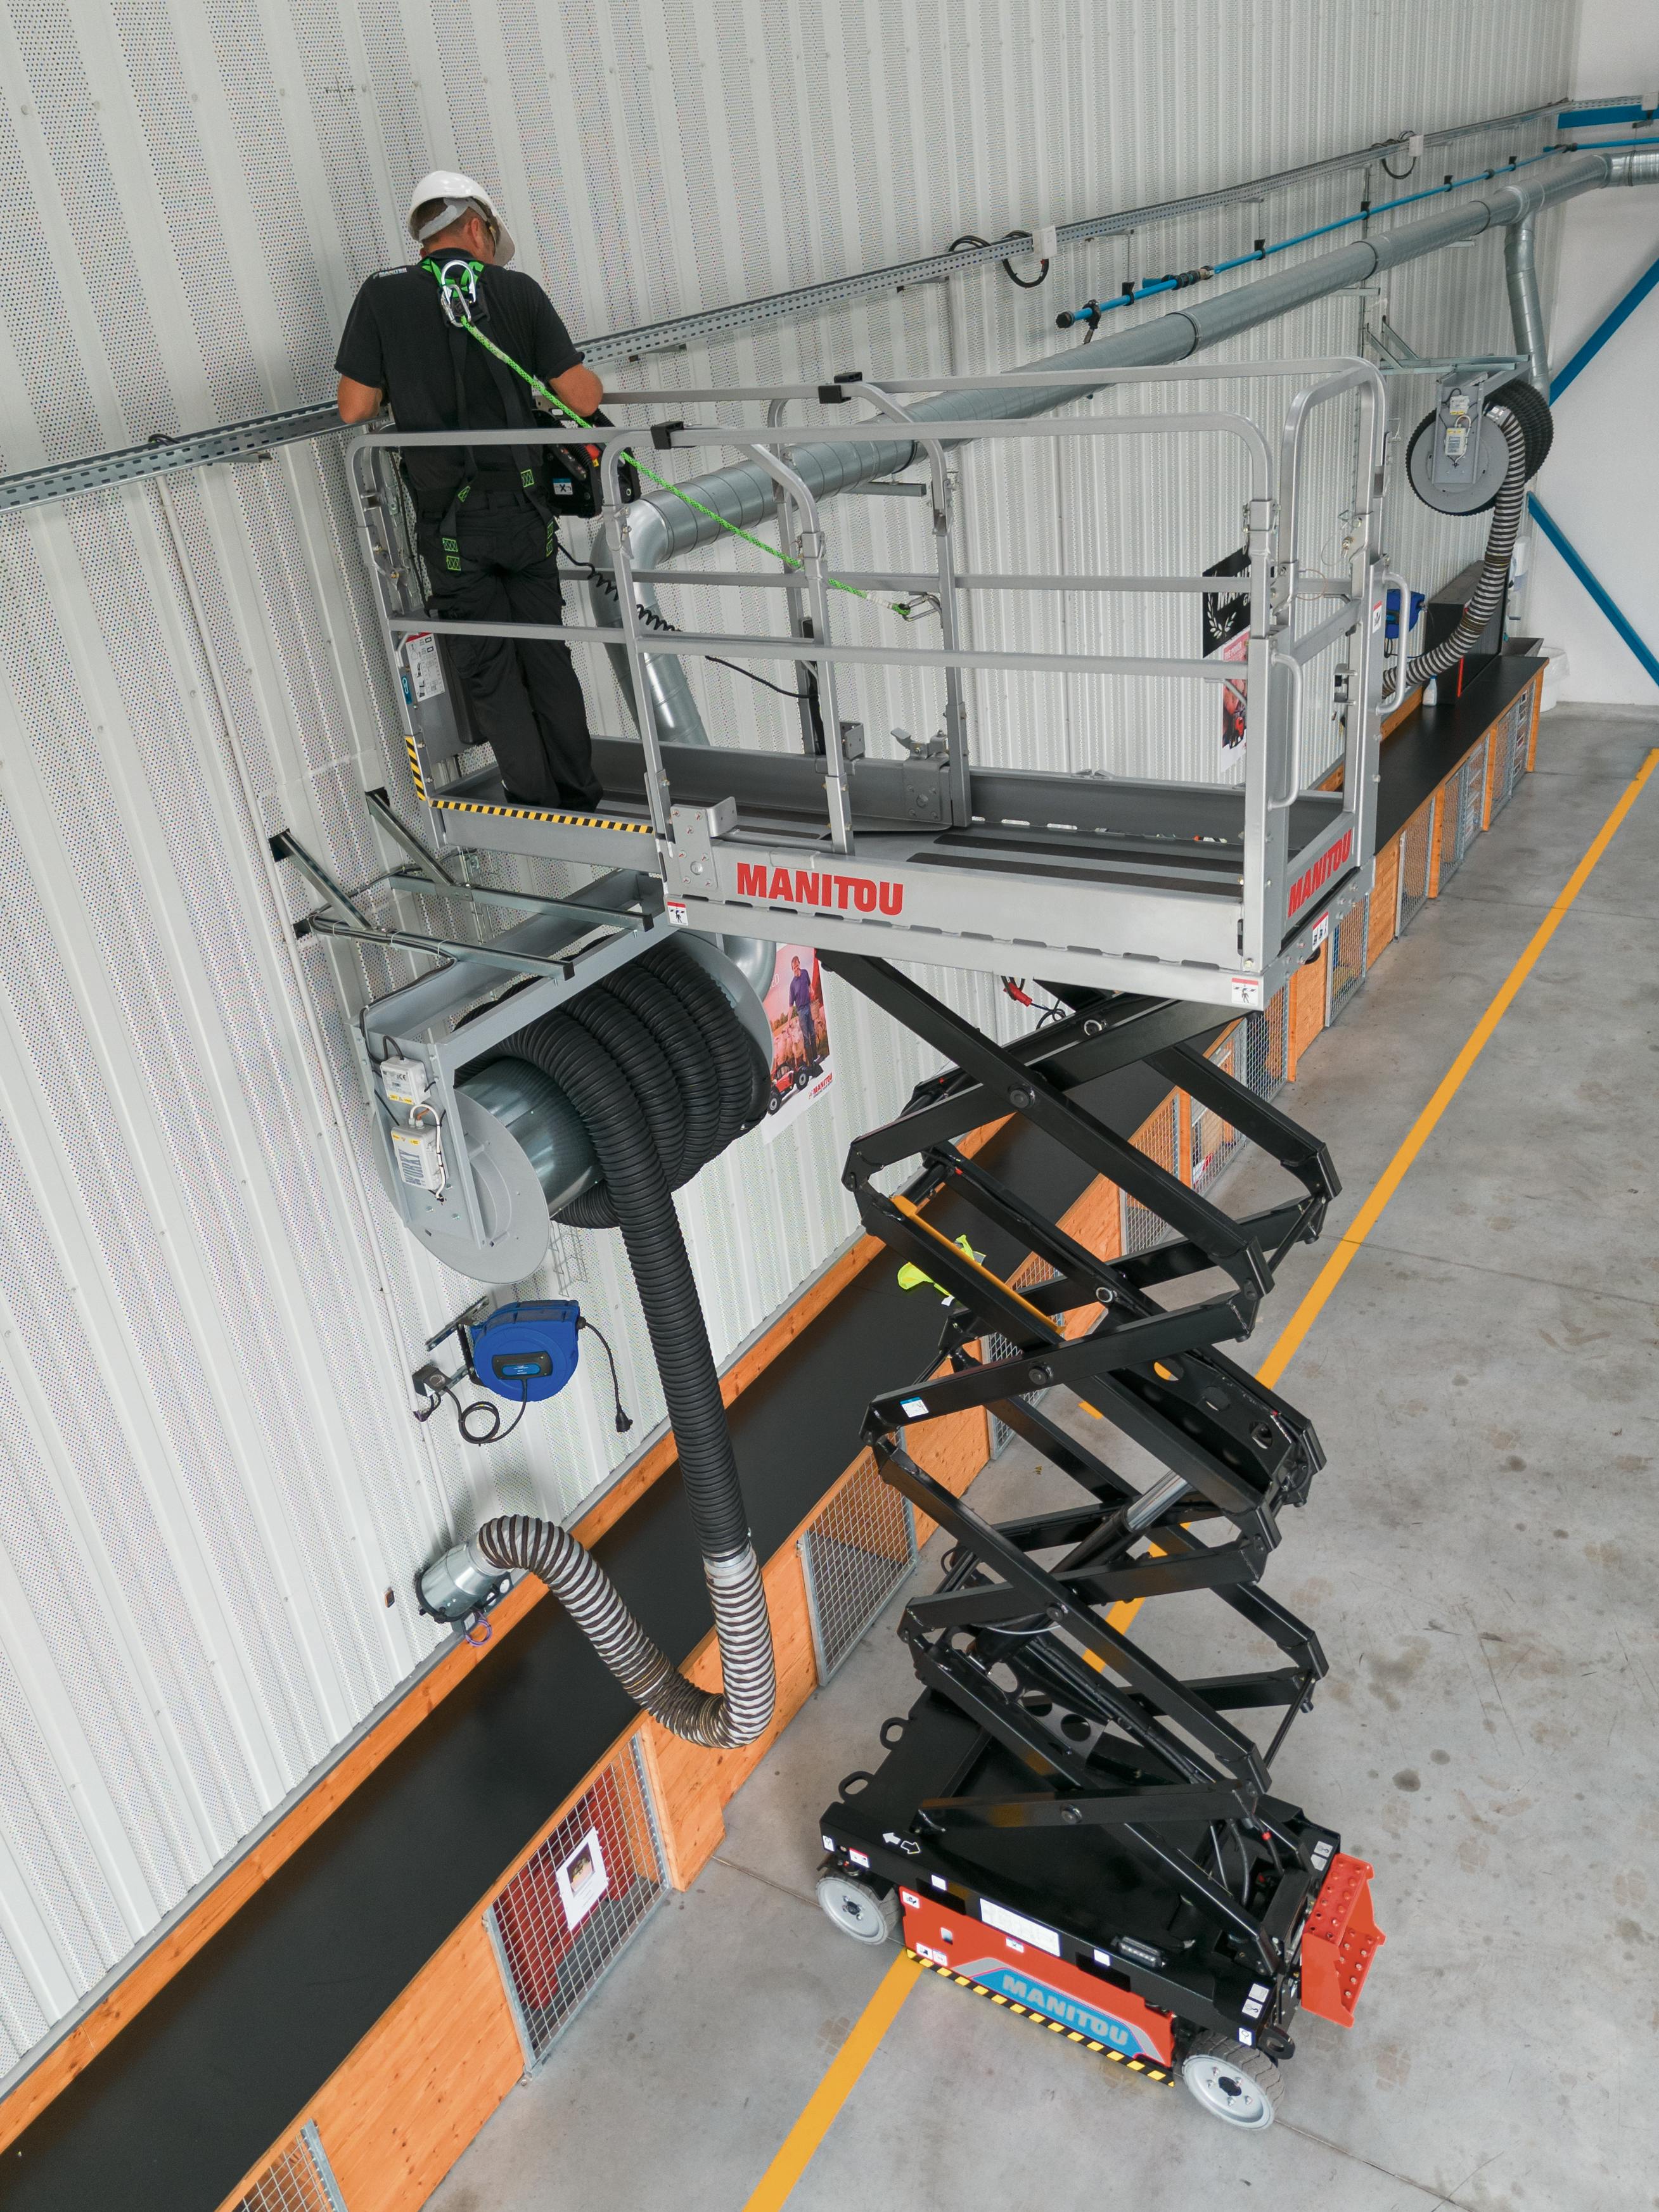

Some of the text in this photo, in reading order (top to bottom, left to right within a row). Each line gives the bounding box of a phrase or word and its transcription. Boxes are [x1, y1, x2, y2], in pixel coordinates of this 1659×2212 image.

[737, 862, 903, 916] MANITOU
[1288, 828, 1352, 919] MANITOU
[1002, 1974, 1129, 2046] MANITOU
